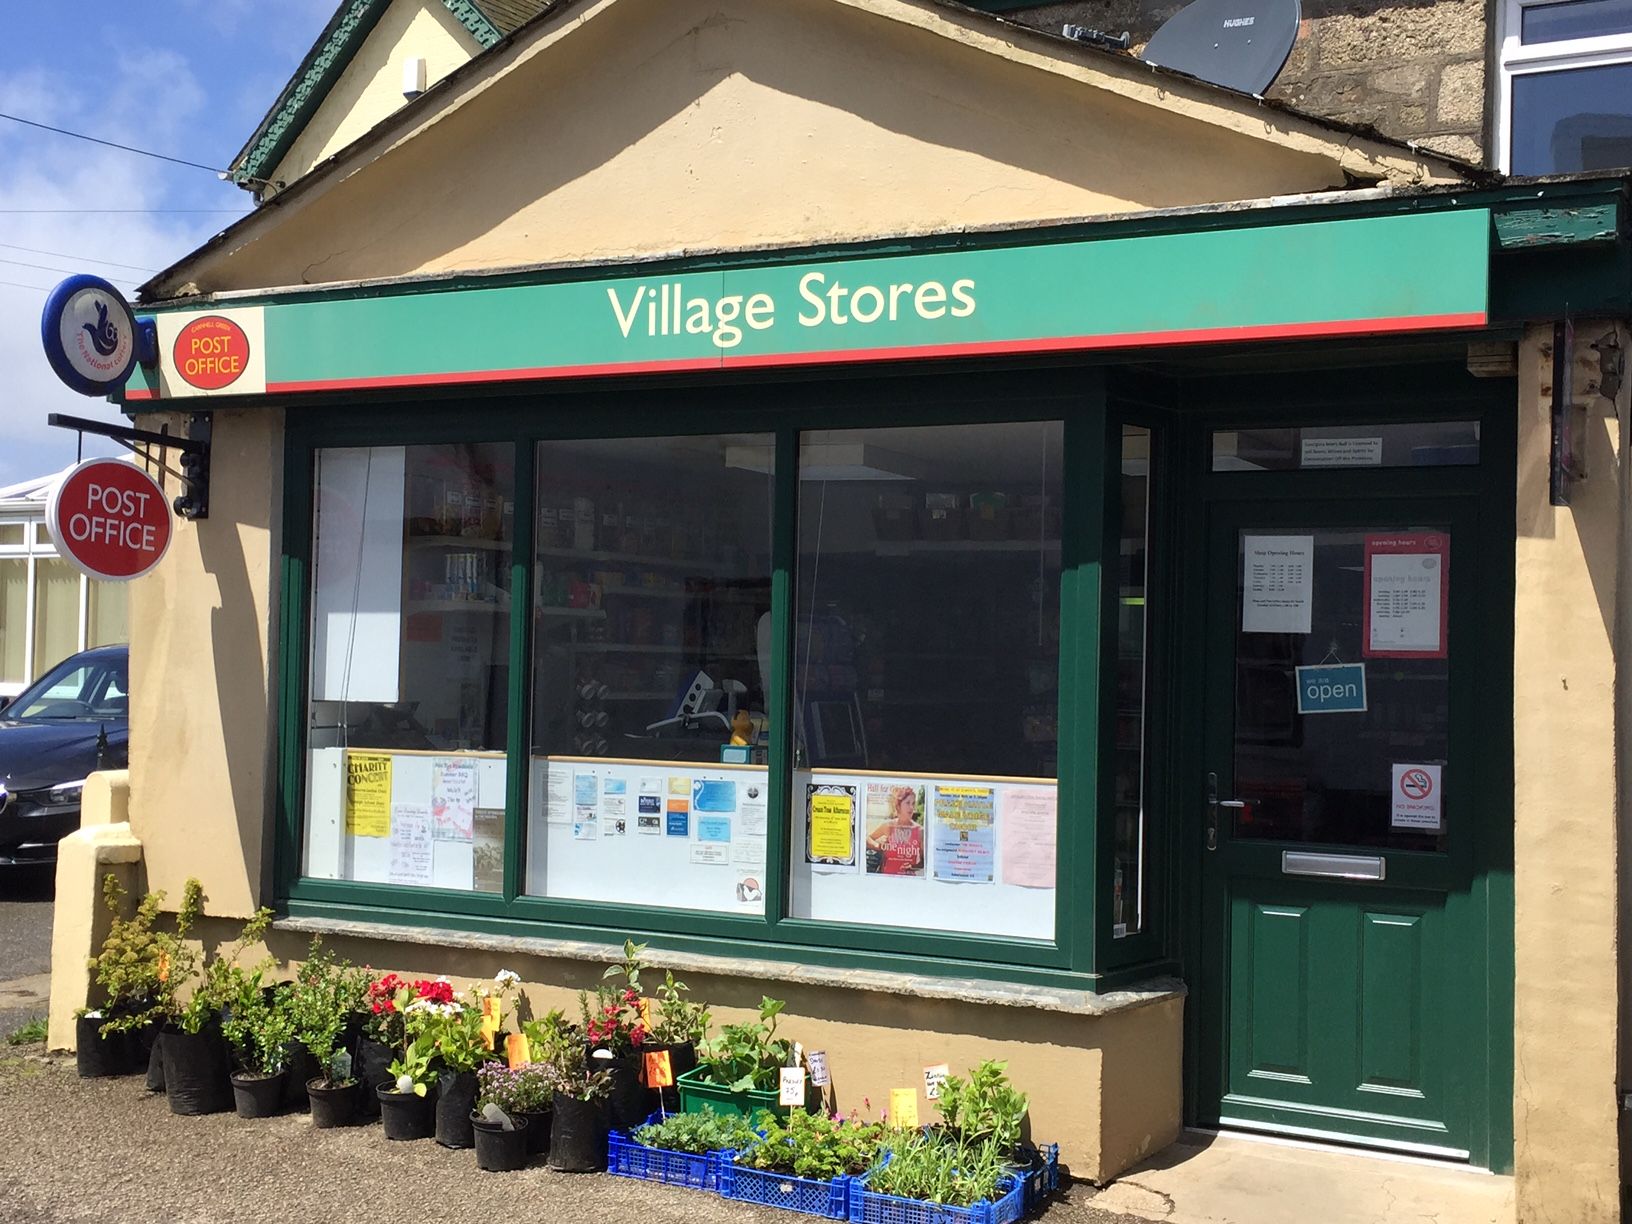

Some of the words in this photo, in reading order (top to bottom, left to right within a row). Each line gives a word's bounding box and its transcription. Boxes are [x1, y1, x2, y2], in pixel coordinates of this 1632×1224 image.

[1223, 17, 1255, 28] HUGHES
[607, 282, 775, 348] Village
[799, 272, 977, 327] Stores
[191, 336, 231, 354] POST
[185, 356, 240, 375] OFFICE
[87, 483, 151, 519] POST
[69, 513, 157, 551] OFFICE
[1371, 538, 1397, 546] opening
[1397, 538, 1416, 546] hours
[1307, 683, 1357, 703] open
[348, 762, 387, 774] CHARITY
[348, 771, 388, 785] CONCERT
[880, 842, 898, 851] one
[897, 845, 920, 858] night
